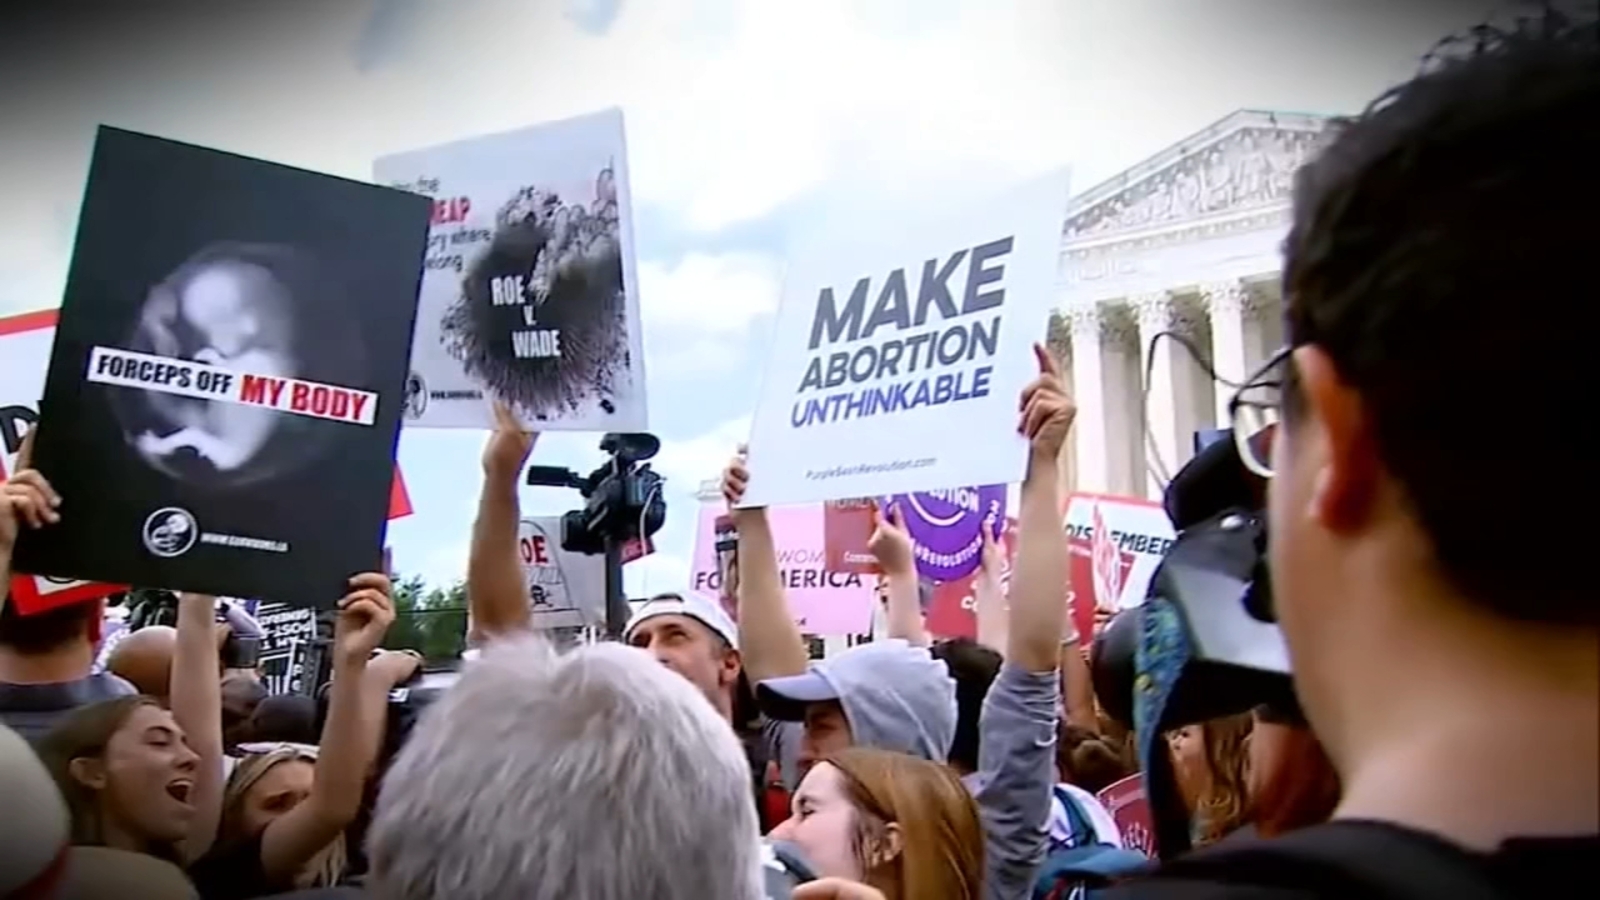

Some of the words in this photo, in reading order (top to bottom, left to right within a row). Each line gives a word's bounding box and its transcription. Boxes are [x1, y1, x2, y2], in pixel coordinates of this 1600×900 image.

[491, 275, 526, 306] ROE
[808, 235, 1014, 350] MAKE
[512, 329, 562, 358] WADE
[797, 316, 1001, 393] ABORTION
[97, 354, 192, 388] FORCEPS
[196, 370, 233, 394] OFF
[241, 374, 286, 406] MY
[291, 382, 369, 421] BODY
[790, 366, 993, 428] UNTHINKABLE
[520, 535, 548, 564] OE
[1064, 523, 1173, 556] DISEMBER
[776, 549, 825, 565] WOM
[694, 571, 723, 591] FO
[780, 568, 862, 591] ERICA
